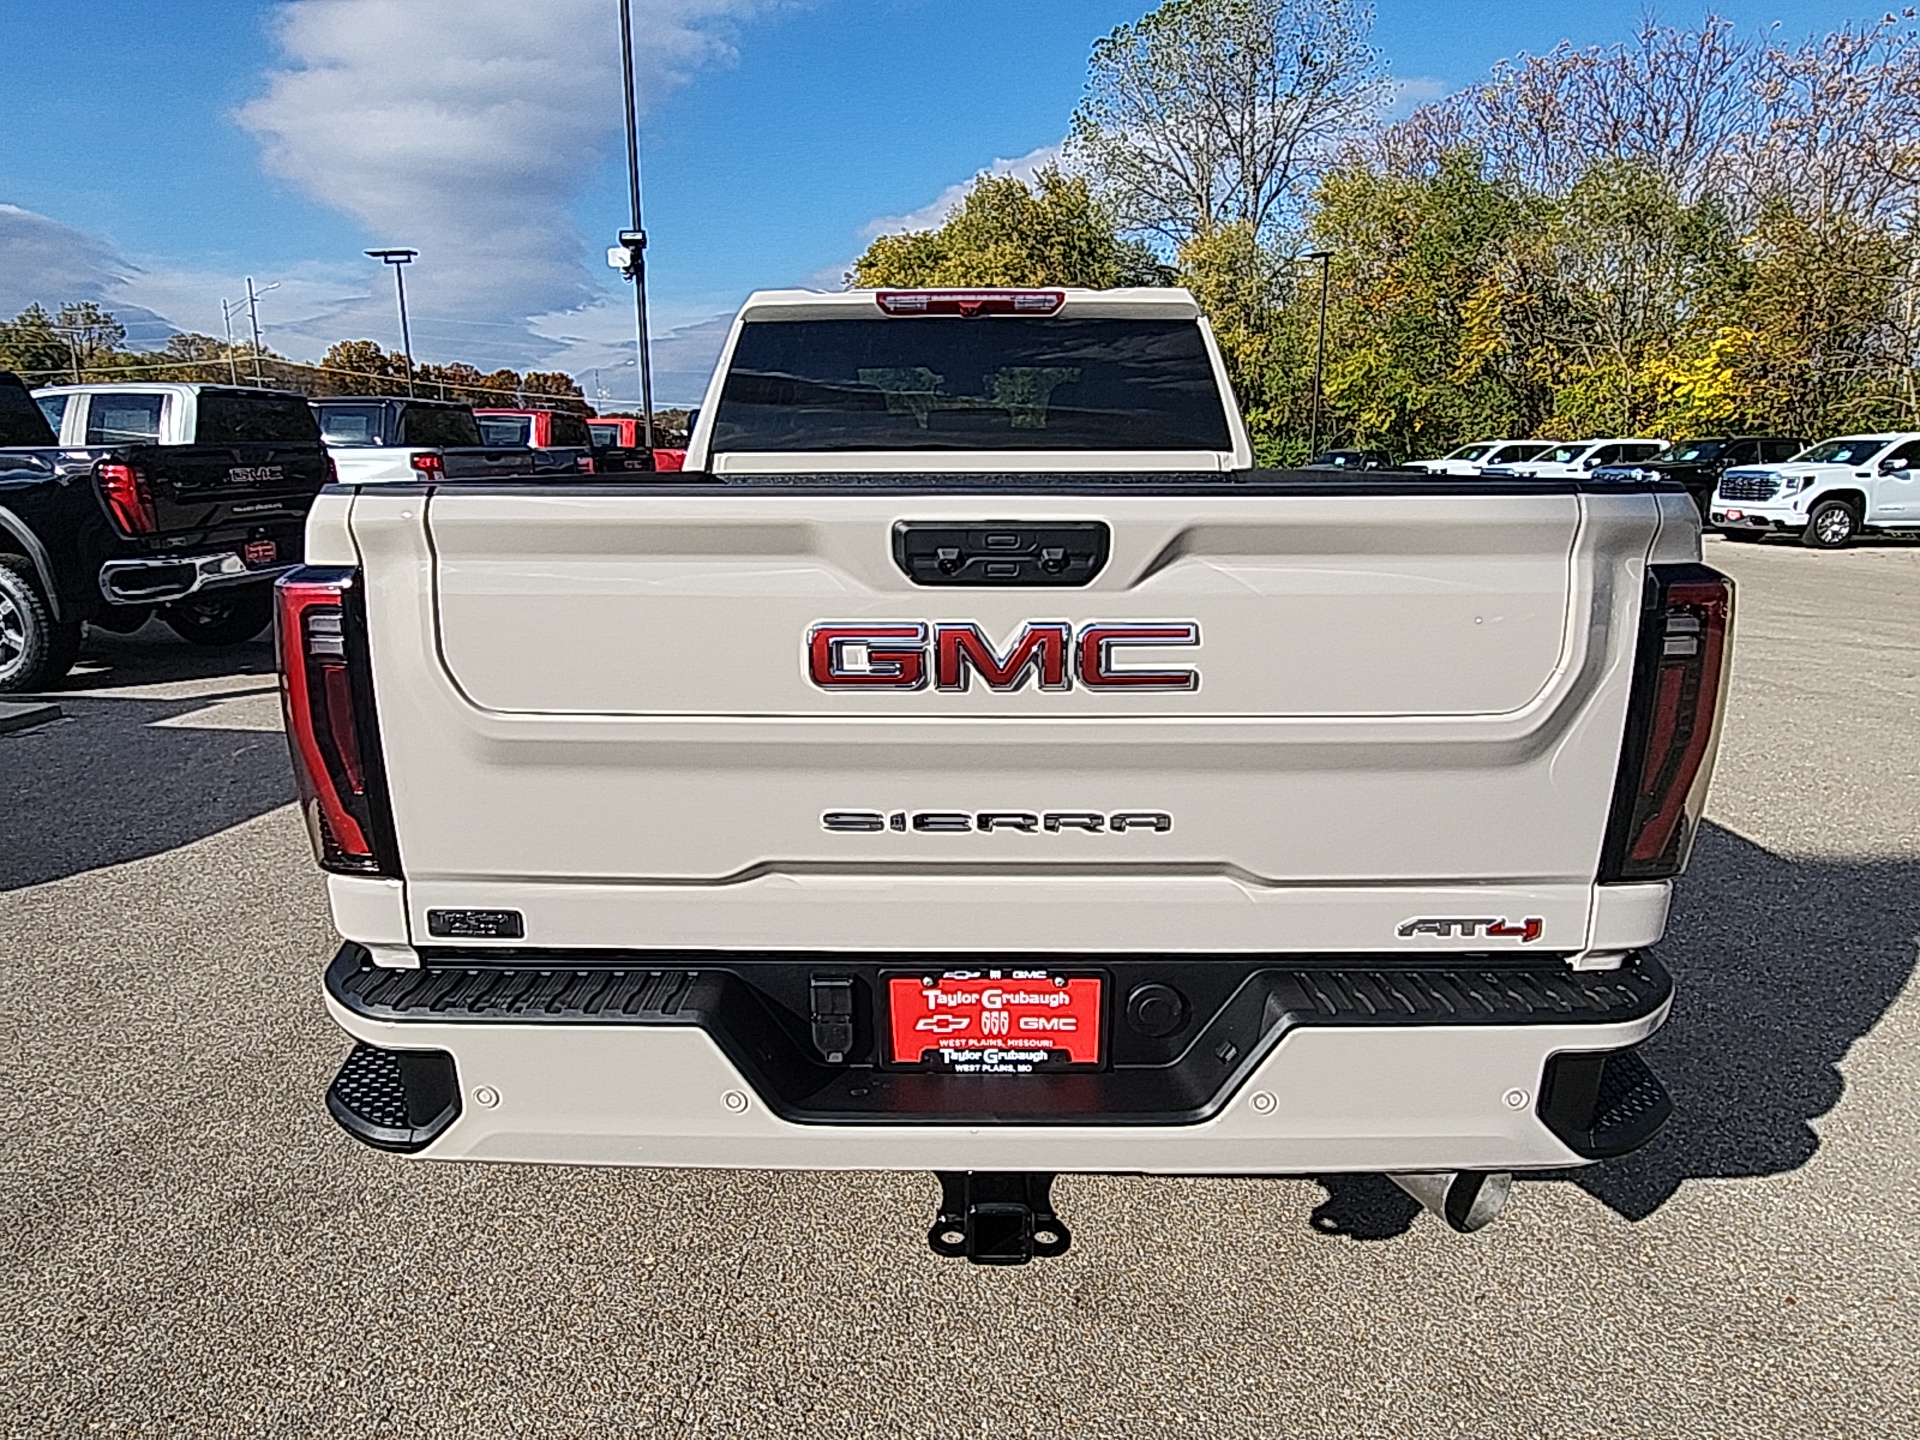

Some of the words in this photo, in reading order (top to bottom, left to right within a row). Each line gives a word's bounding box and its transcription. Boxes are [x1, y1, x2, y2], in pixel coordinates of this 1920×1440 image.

[229, 466, 284, 482] GMC
[807, 620, 1201, 694] GMC
[822, 811, 1173, 834] SIERRA
[1397, 917, 1543, 943] AT4
[1012, 970, 1047, 979] GMC
[923, 989, 979, 1010] Taylor
[981, 989, 1070, 1008] Grubaugh
[1019, 1017, 1077, 1031] GMC
[939, 1039, 966, 1047] WEST
[968, 1039, 1005, 1048] PLAINS,
[1007, 1039, 1053, 1047] MISSOURI
[939, 1049, 982, 1064] Taylor
[983, 1048, 1048, 1064] Grubaugh
[955, 1064, 980, 1072] WEST
[1017, 1064, 1032, 1072] MO
